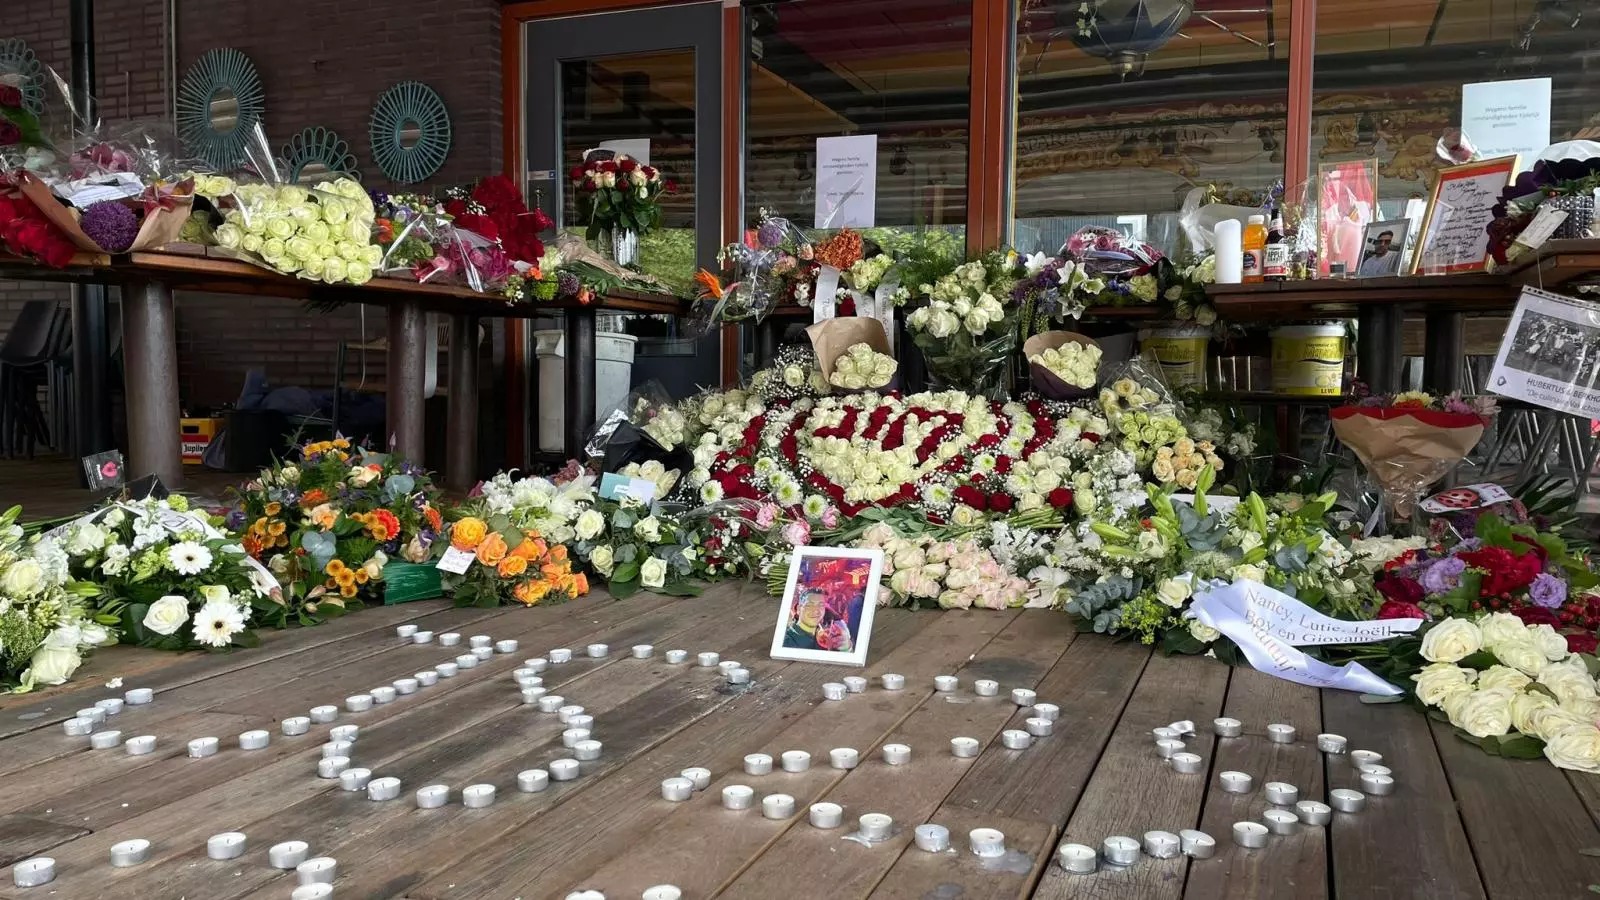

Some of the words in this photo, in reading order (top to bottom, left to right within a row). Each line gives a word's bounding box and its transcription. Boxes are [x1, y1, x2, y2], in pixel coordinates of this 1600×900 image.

[1526, 378, 1566, 394] HUBERTUS
[1245, 588, 1294, 625] Nancy,
[1245, 609, 1276, 631] Boy
[1278, 628, 1296, 641] en
